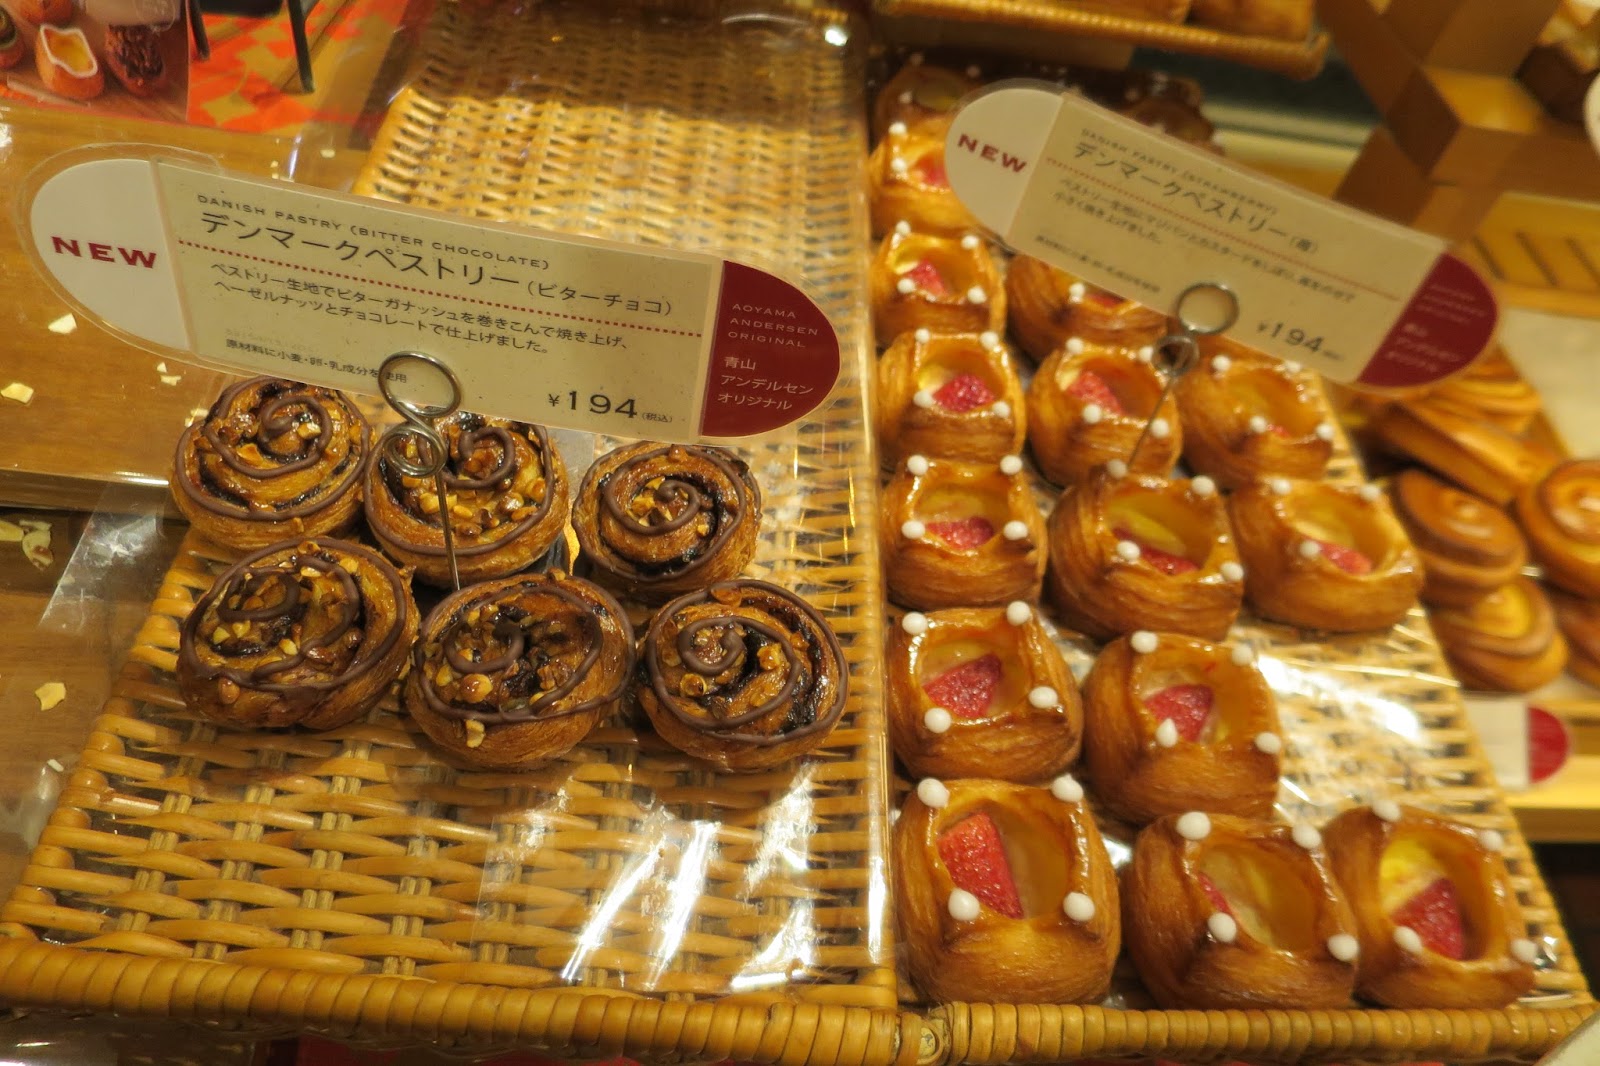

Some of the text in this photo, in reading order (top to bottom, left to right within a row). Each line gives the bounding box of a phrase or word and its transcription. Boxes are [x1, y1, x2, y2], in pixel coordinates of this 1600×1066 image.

[957, 133, 1027, 173] NEW
[197, 194, 549, 271] DANISH PASTRY (BITTER CHOCOLATE)
[51, 236, 157, 269] NEW
[732, 303, 796, 319] AOYAMA
[730, 317, 818, 336] ANDERSEN
[728, 331, 806, 348] ORIGINAL
[724, 356, 756, 371] 青山
[721, 375, 813, 394] アンデルセン
[548, 390, 638, 418] ¥194
[718, 393, 793, 410] オリジナル
